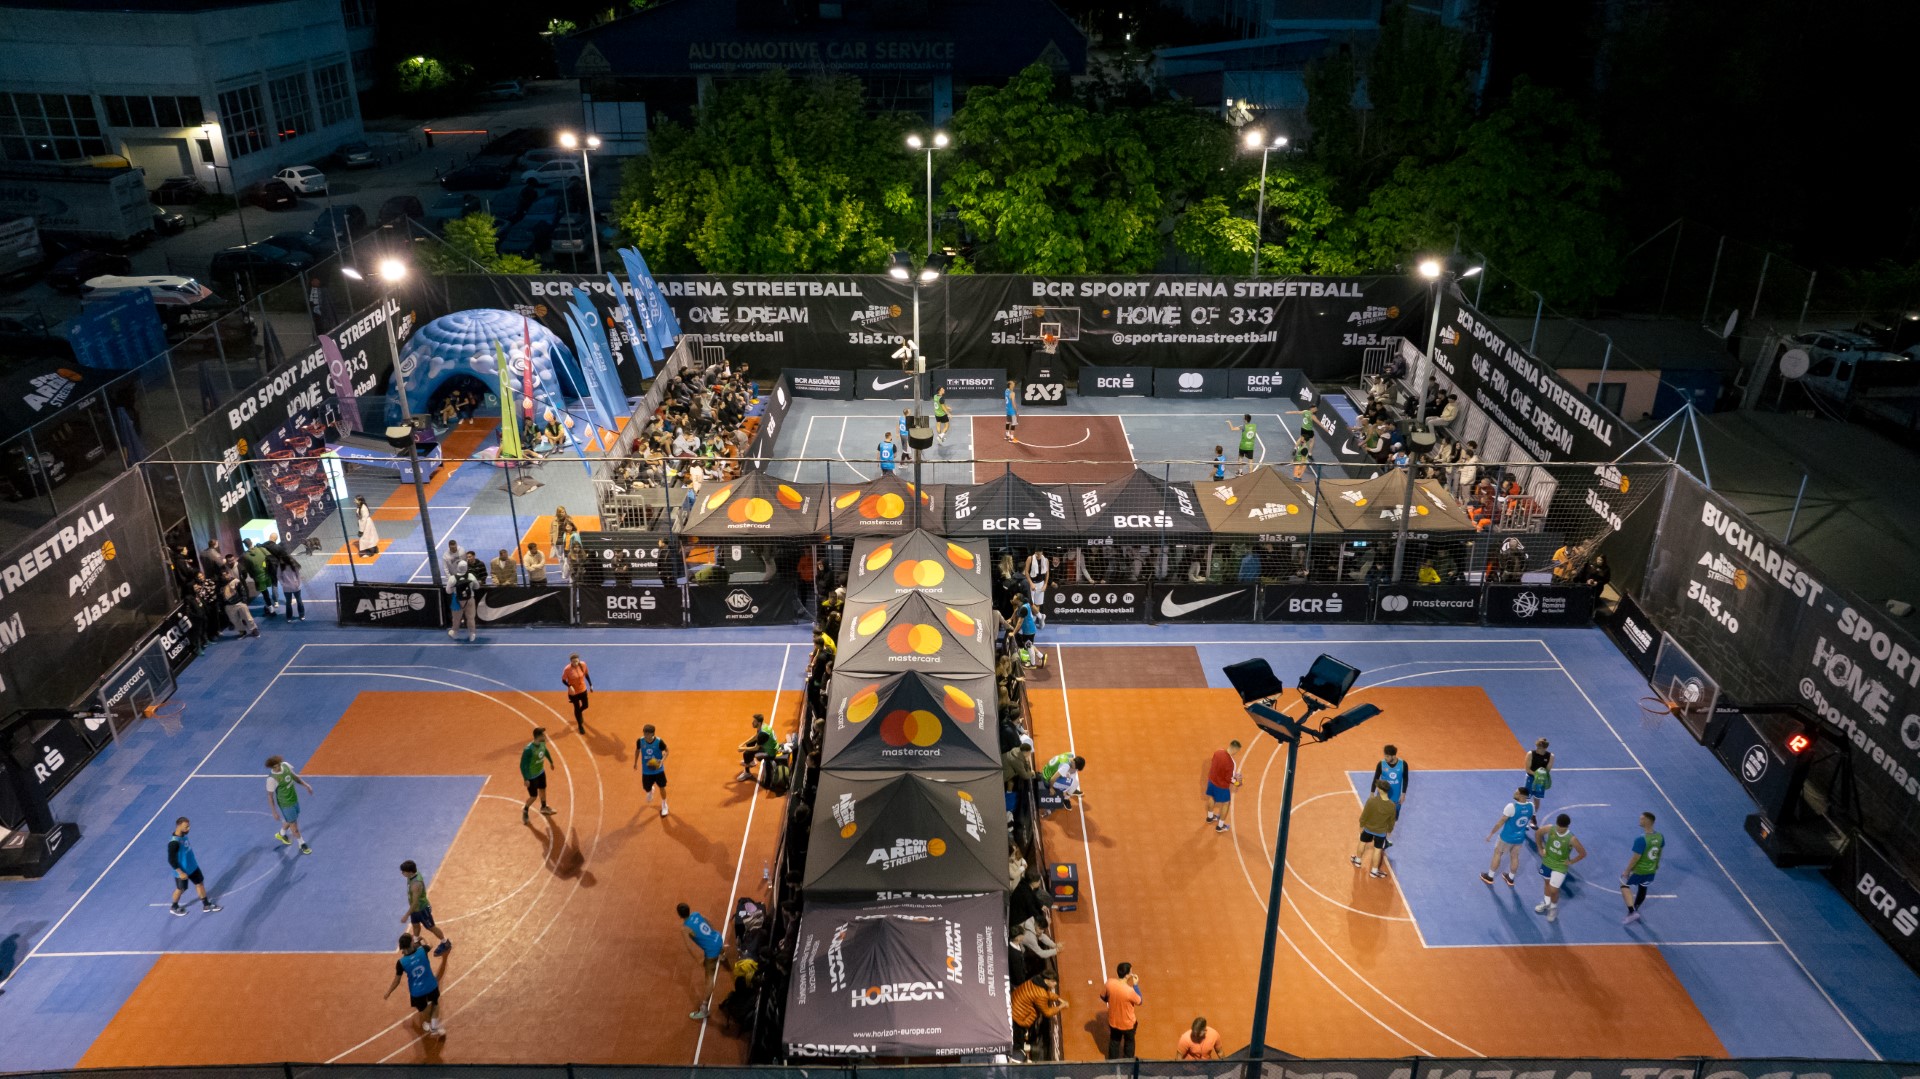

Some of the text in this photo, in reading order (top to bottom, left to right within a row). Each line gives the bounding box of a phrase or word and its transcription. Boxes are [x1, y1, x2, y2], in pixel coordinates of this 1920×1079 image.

[688, 41, 955, 60] AUTOMOTIVE CAR SERVICE
[530, 281, 574, 297] BCR
[657, 281, 728, 297] ARENA
[732, 282, 863, 297] STREETBALL
[1032, 281, 1364, 298] BCR SPORT ARENA STREETBALL
[688, 306, 729, 324] ONE
[736, 305, 809, 325] DREAM
[850, 308, 890, 321] ARENA
[861, 315, 890, 326] STREETBALL
[1116, 305, 1182, 325] HOME
[1190, 305, 1221, 325] OF
[1347, 309, 1387, 322] ARENA
[848, 332, 905, 345] 3la3.ro
[1111, 331, 1278, 346] @sportarenastreetball
[960, 378, 995, 386] TISSOT
[1097, 377, 1121, 388] BCR
[1247, 375, 1270, 386] BCR
[1456, 307, 1614, 448] BCR SPORT ARENA STREETBALL
[1247, 385, 1272, 393] Leasing
[227, 396, 259, 431] BCR
[258, 365, 298, 408] SPORT
[1585, 488, 1622, 532] 3la3.ro
[982, 517, 1020, 531] BCR
[1114, 515, 1153, 528] BCR
[1087, 538, 1104, 546] BCR
[1259, 534, 1297, 542] 3la3.ro
[80, 548, 103, 566] SPORT
[1697, 551, 1736, 579] ARENA
[69, 554, 105, 598] ARENA
[378, 591, 408, 600] SPORT
[606, 595, 638, 610] BCR
[728, 593, 750, 608] KISS
[1701, 501, 1824, 608] BUCHAREST
[1837, 607, 1920, 689] SPORT
[73, 581, 131, 633] 3la3.ro
[355, 598, 410, 614] ARENA
[1289, 598, 1323, 613] BCR
[1412, 598, 1474, 609] mastercard
[1687, 579, 1740, 634] 3la3.ro
[369, 605, 410, 621] STREETBALL
[607, 610, 642, 622] Leasing
[888, 655, 941, 663] mastercard
[1811, 636, 1896, 726] HOME
[1789, 735, 1809, 752] 12
[1799, 677, 1920, 803] @sportarenas
[881, 748, 941, 757] mastercard
[895, 838, 928, 848] SPORT
[866, 846, 928, 865] ARENA
[882, 852, 928, 871] STREETBALL
[1856, 872, 1897, 918] BCR
[851, 981, 945, 1008] HORIZON
[852, 1026, 942, 1038] www.horizon-europe.com
[788, 1042, 877, 1058] HORIZON
[935, 1047, 974, 1056] REDEFINIM
